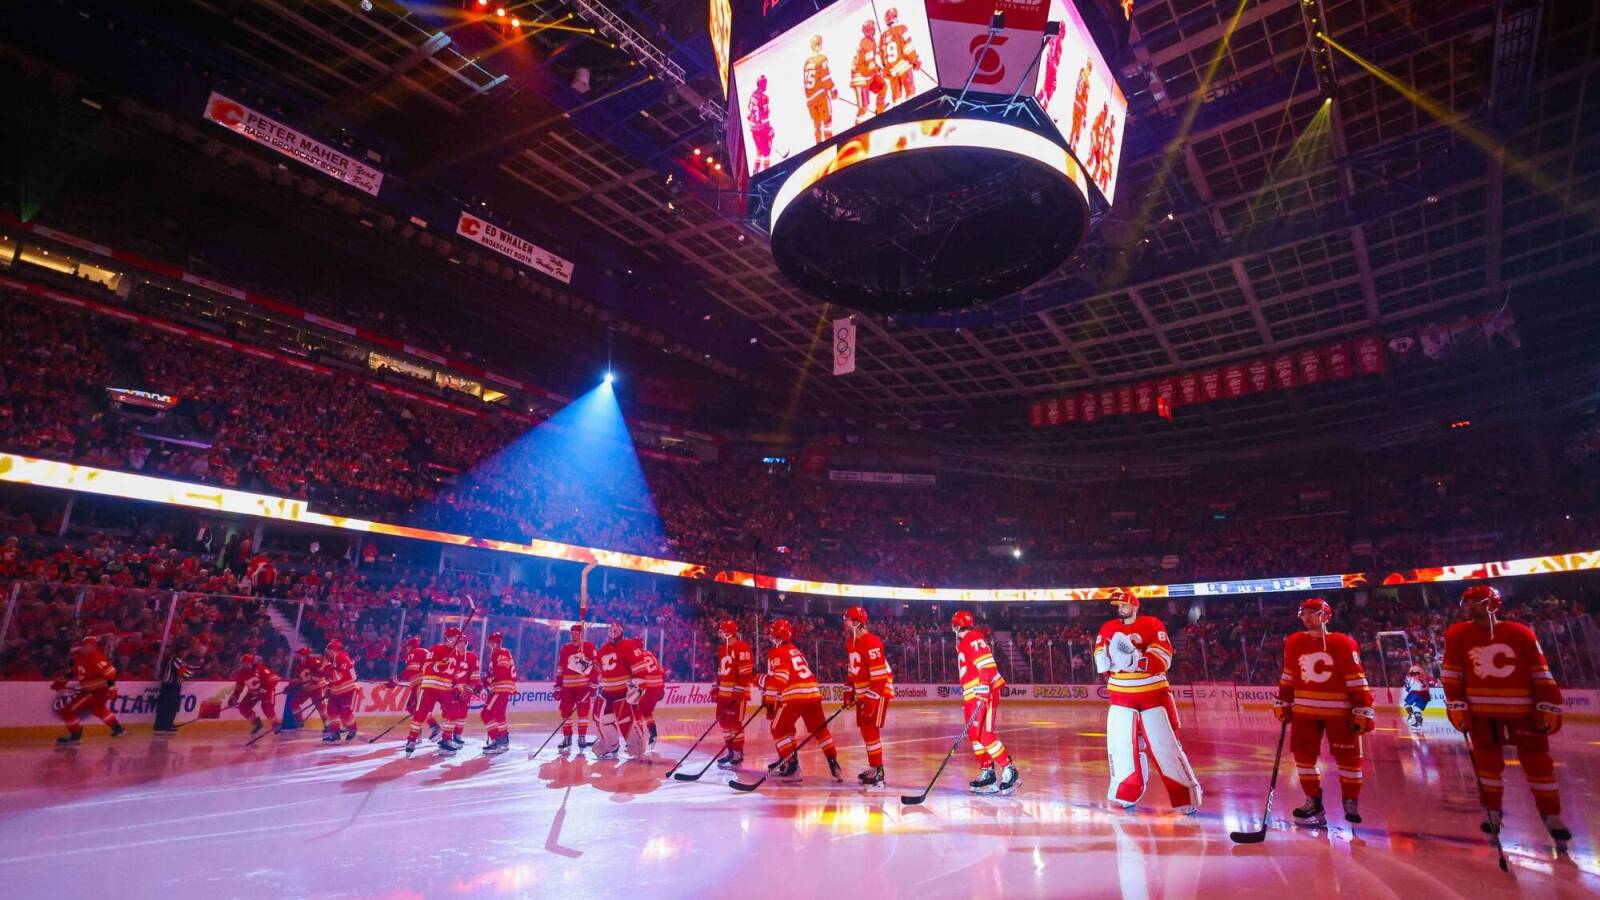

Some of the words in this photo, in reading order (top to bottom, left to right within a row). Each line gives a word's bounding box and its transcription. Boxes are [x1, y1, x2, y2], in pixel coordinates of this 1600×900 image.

[247, 113, 296, 144] PETER
[300, 139, 349, 169] MAHER
[244, 125, 271, 142] RADIO
[271, 138, 321, 166] BROADCAST
[320, 159, 346, 177] BOOTH
[481, 236, 513, 256] BROADCAST
[484, 224, 497, 237] ED
[499, 232, 534, 254] WHALEN
[868, 648, 881, 659] 55
[970, 638, 987, 651] 73
[364, 684, 411, 712] SKI
[509, 690, 554, 706] upreme
[665, 686, 687, 704] Tim
[894, 687, 928, 698] Scotiabank
[1033, 686, 1071, 698] PIZZA
[1072, 686, 1088, 698] 73
[1237, 691, 1280, 700] ORIGIN
[110, 694, 197, 714] CLAMTO
